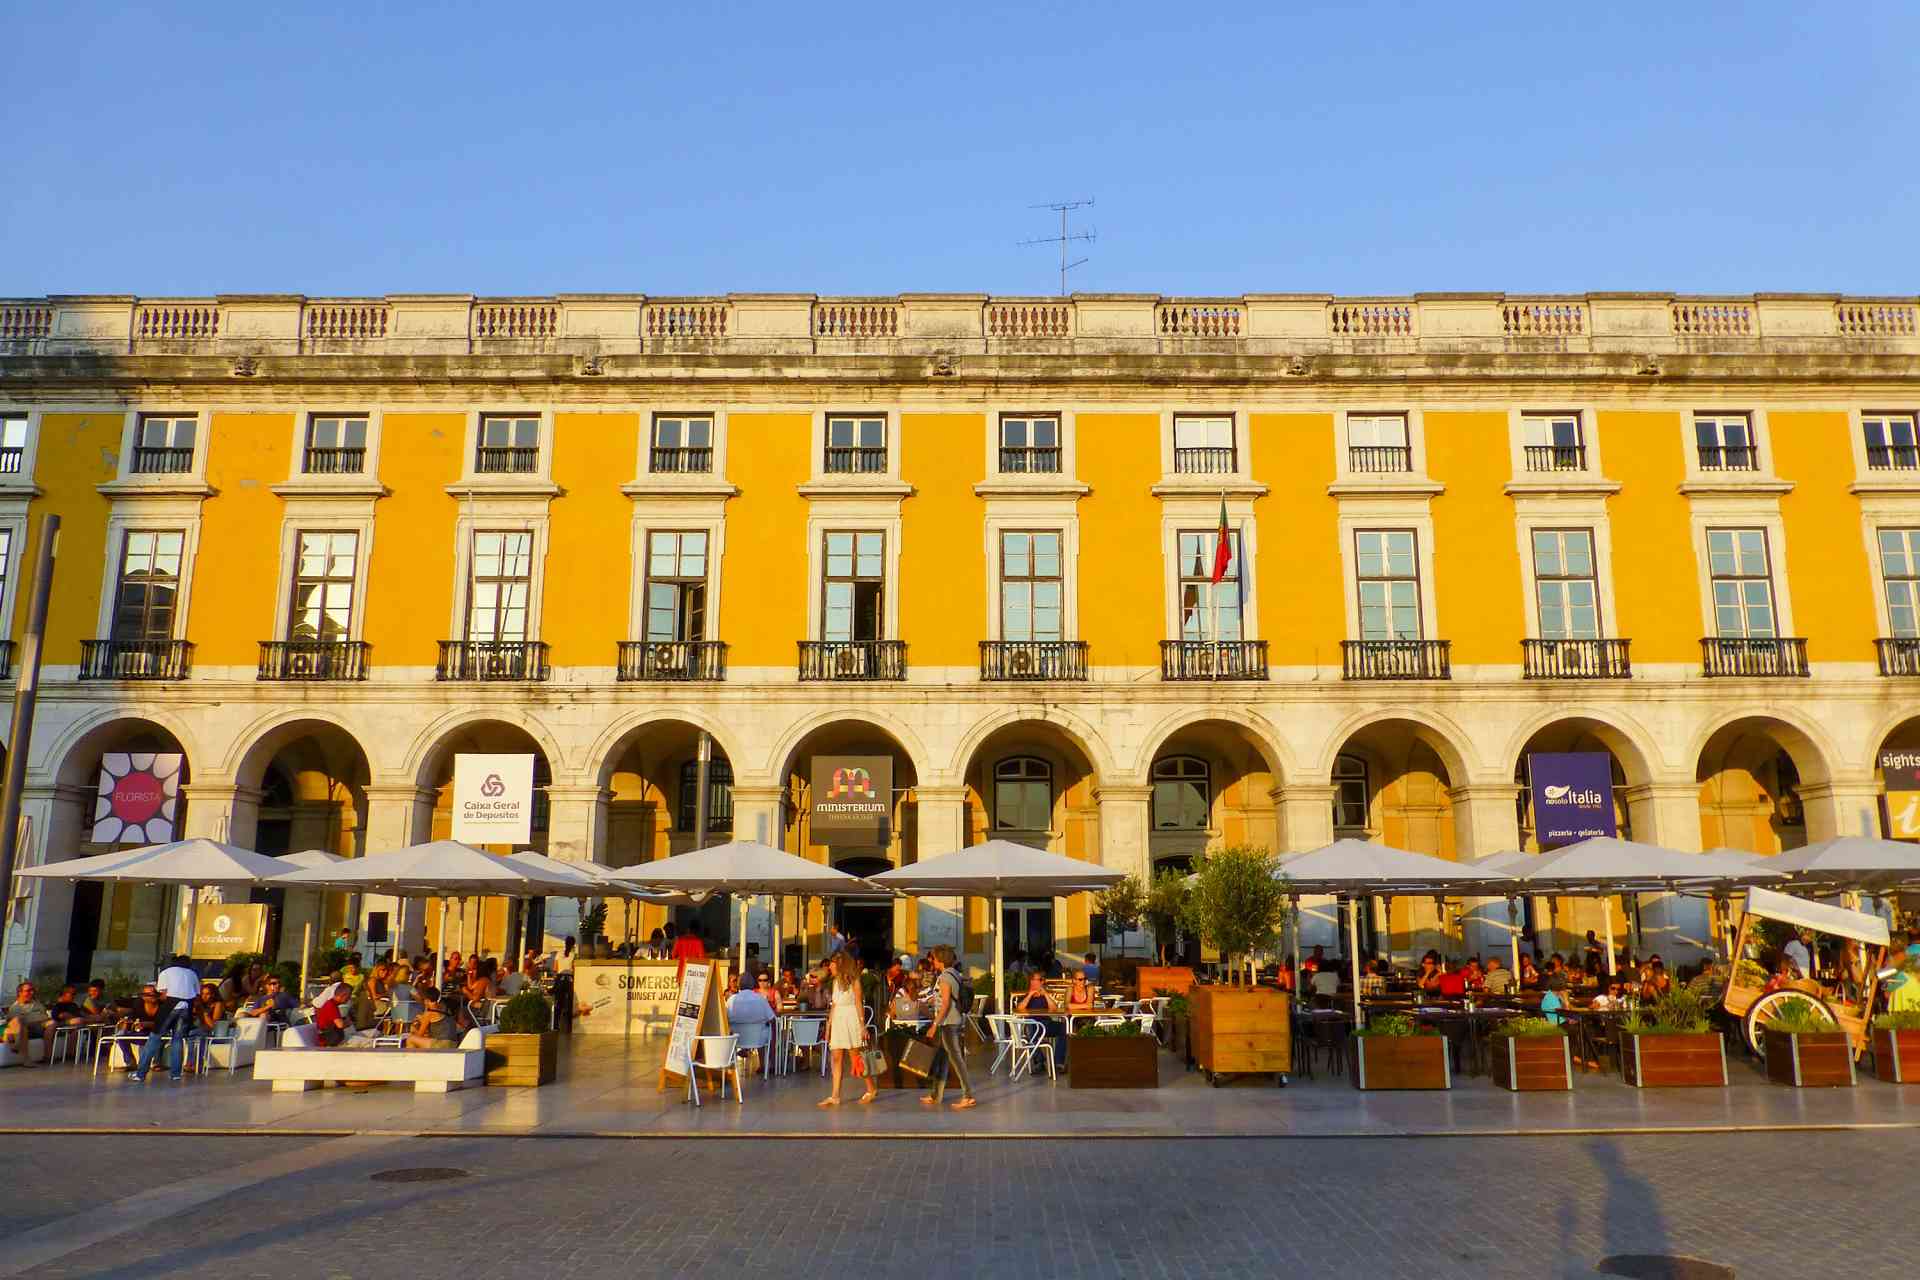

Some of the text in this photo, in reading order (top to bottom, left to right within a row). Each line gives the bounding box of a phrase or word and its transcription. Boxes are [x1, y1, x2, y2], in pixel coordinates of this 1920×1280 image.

[115, 791, 161, 802] FLORISTA
[1568, 789, 1602, 804] Italia
[464, 800, 520, 810] Caixa Geral
[626, 991, 656, 1001] SUNSET
